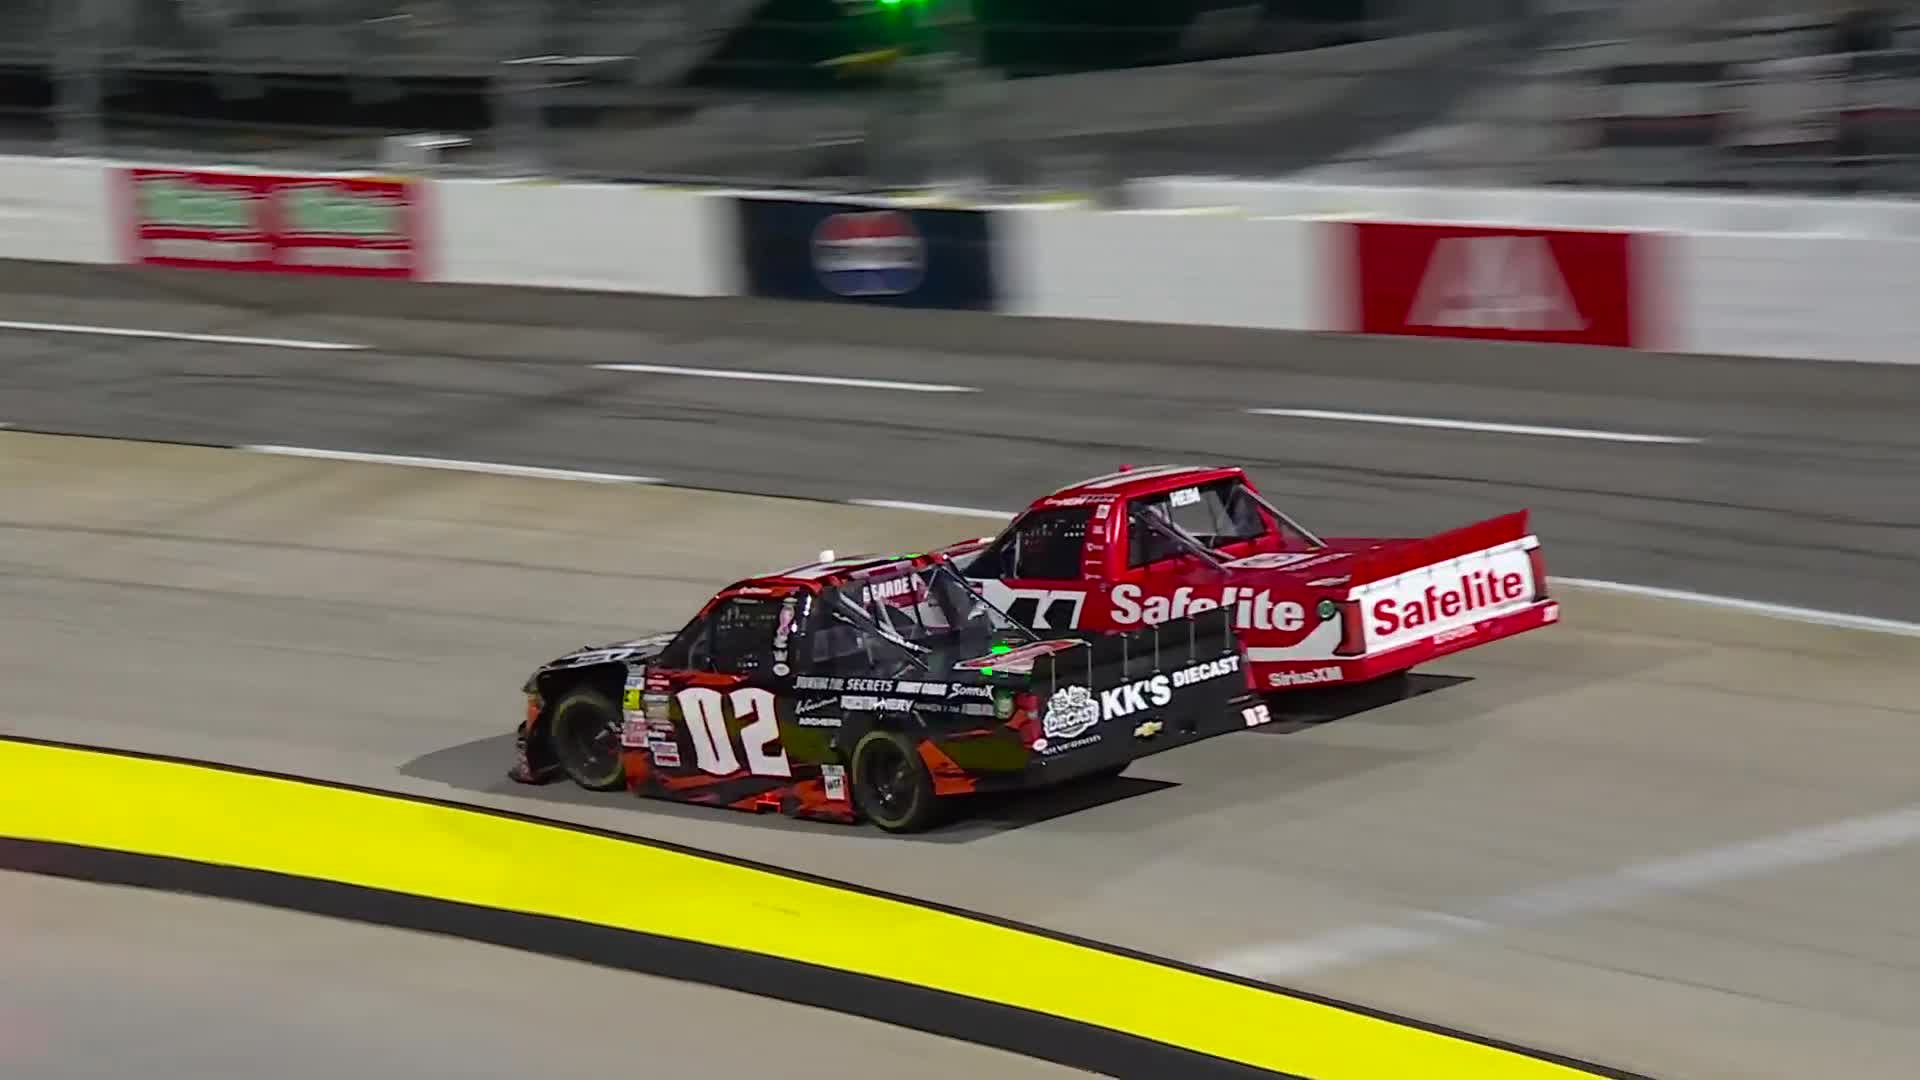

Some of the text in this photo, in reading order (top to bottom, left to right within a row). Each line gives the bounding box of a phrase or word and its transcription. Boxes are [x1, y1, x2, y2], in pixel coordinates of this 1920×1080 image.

[1374, 571, 1522, 636] Safelite
[846, 678, 894, 692] SECRETS
[1101, 656, 1240, 720] KK'S DIECAST
[1268, 666, 1344, 687] SiriusXM
[676, 687, 792, 777] 02
